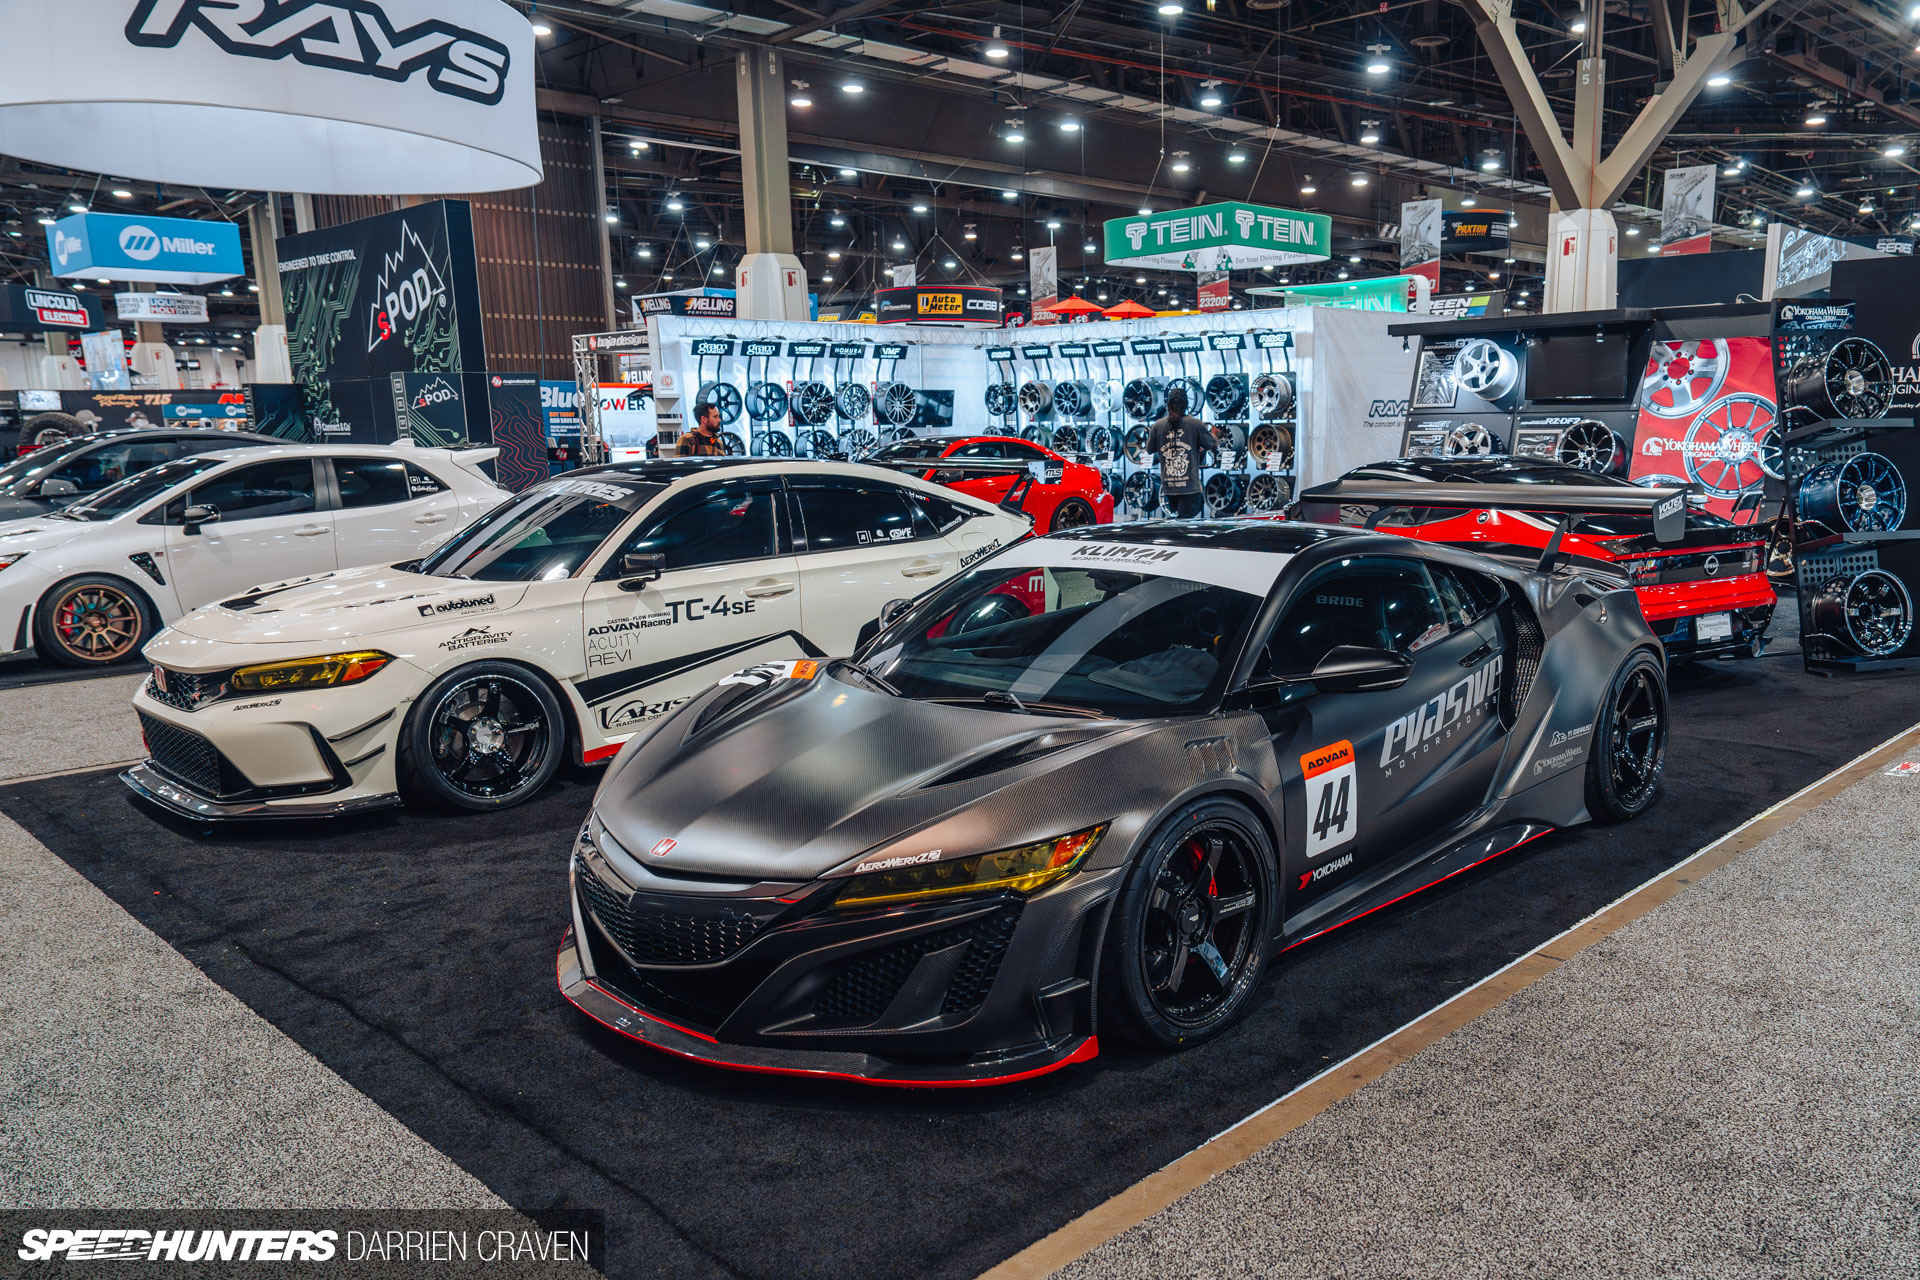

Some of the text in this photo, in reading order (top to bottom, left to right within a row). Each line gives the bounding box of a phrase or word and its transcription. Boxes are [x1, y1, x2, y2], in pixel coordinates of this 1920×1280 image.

[125, 0, 510, 105] RAYS
[768, 51, 776, 62] N
[769, 64, 776, 74] 6
[1582, 58, 1591, 70] N
[1582, 74, 1590, 85] 5
[1151, 212, 1223, 245] TEIN
[1257, 214, 1314, 246] TEIN
[1456, 224, 1488, 234] PAXTON
[163, 236, 214, 256] Miller
[278, 249, 356, 273] ENGINEERED TO TAKE CONTROL
[1235, 255, 1245, 264] For
[1246, 254, 1260, 263] Your
[1260, 254, 1282, 265] Driving
[29, 293, 79, 312] LINCOLN
[149, 298, 177, 306] LIQUI
[643, 297, 671, 312] MELLING
[688, 298, 734, 312] MELLING
[931, 295, 956, 304] Auto
[966, 299, 998, 312] COBB
[1199, 296, 1227, 308] 23200
[149, 306, 177, 315] MOLY
[929, 303, 961, 313] Meter
[1794, 305, 1826, 316] YOKOHAMA
[43, 310, 84, 325] ELECTRIC
[1007, 315, 1024, 328] aFe
[597, 333, 649, 349] baja designs
[697, 341, 728, 355] gram
[747, 343, 776, 356] gram
[882, 347, 901, 355] VMF
[624, 370, 652, 384] MELLIN
[143, 394, 173, 405] 715
[1663, 437, 1760, 452] YOKOHAMA WHEEL
[1658, 493, 1684, 515] VOLTEX
[960, 538, 1002, 569] AEROWERKZ
[436, 594, 496, 612] autotuned
[1316, 595, 1364, 608] BRIDE
[647, 611, 671, 619] FORMING
[588, 622, 641, 637] ADVAN
[640, 617, 672, 629] Racing
[438, 631, 513, 648] ANTIGRAVITY
[448, 638, 508, 652] BATTERIES
[589, 648, 632, 668] REVI
[616, 716, 646, 728] RACING
[1385, 696, 1497, 779] MOTORSPORTS
[1566, 746, 1584, 758] WHEEL
[1308, 748, 1349, 771] ADVAN
[1312, 774, 1351, 842] 44
[854, 852, 928, 873] AEROWERKZ
[1313, 853, 1353, 882] YOKOHAMA
